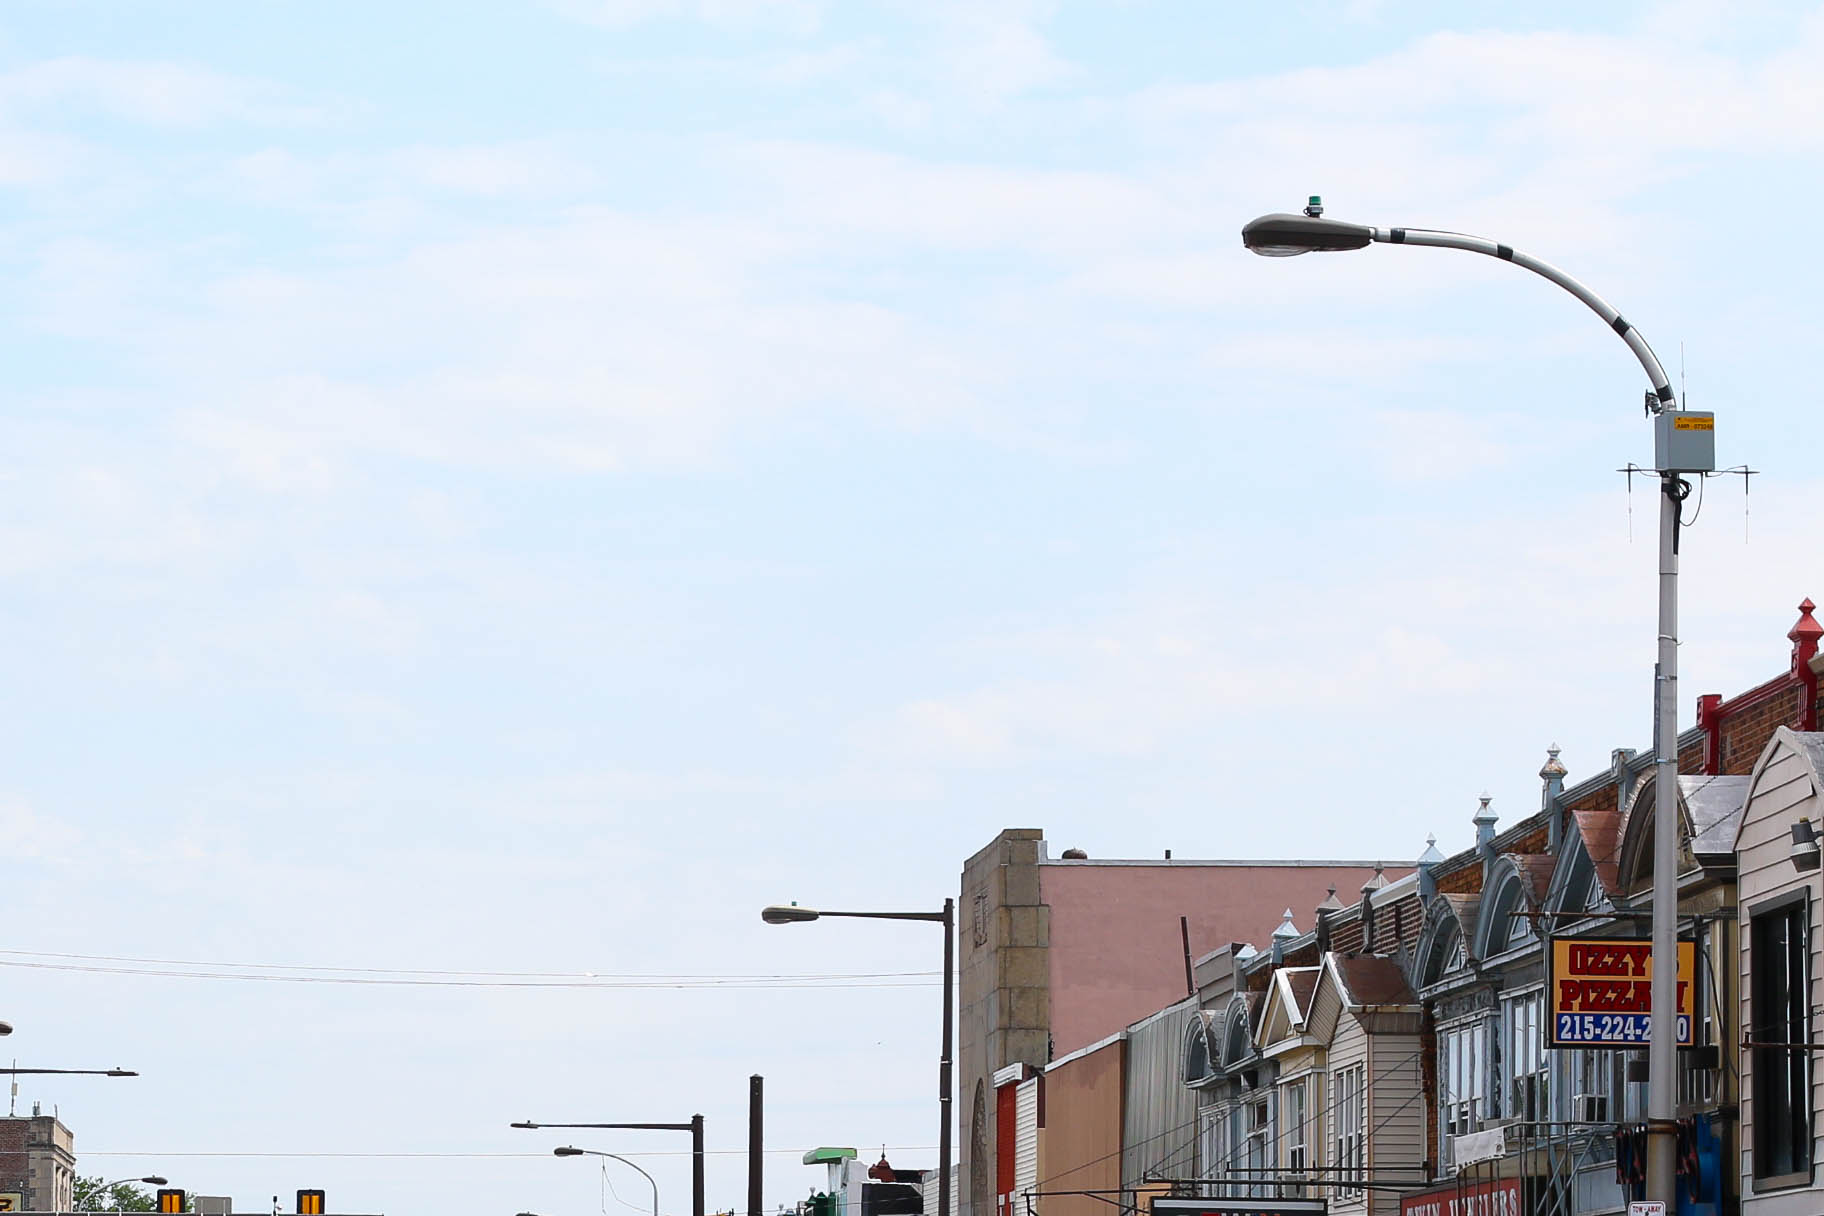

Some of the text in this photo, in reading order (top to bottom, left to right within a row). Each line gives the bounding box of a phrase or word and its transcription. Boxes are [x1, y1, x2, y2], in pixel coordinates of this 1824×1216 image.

[1569, 944, 1679, 976] OZZY
[1559, 980, 1653, 1012] PIZZA
[1561, 1015, 1687, 1040] 215-224-20
